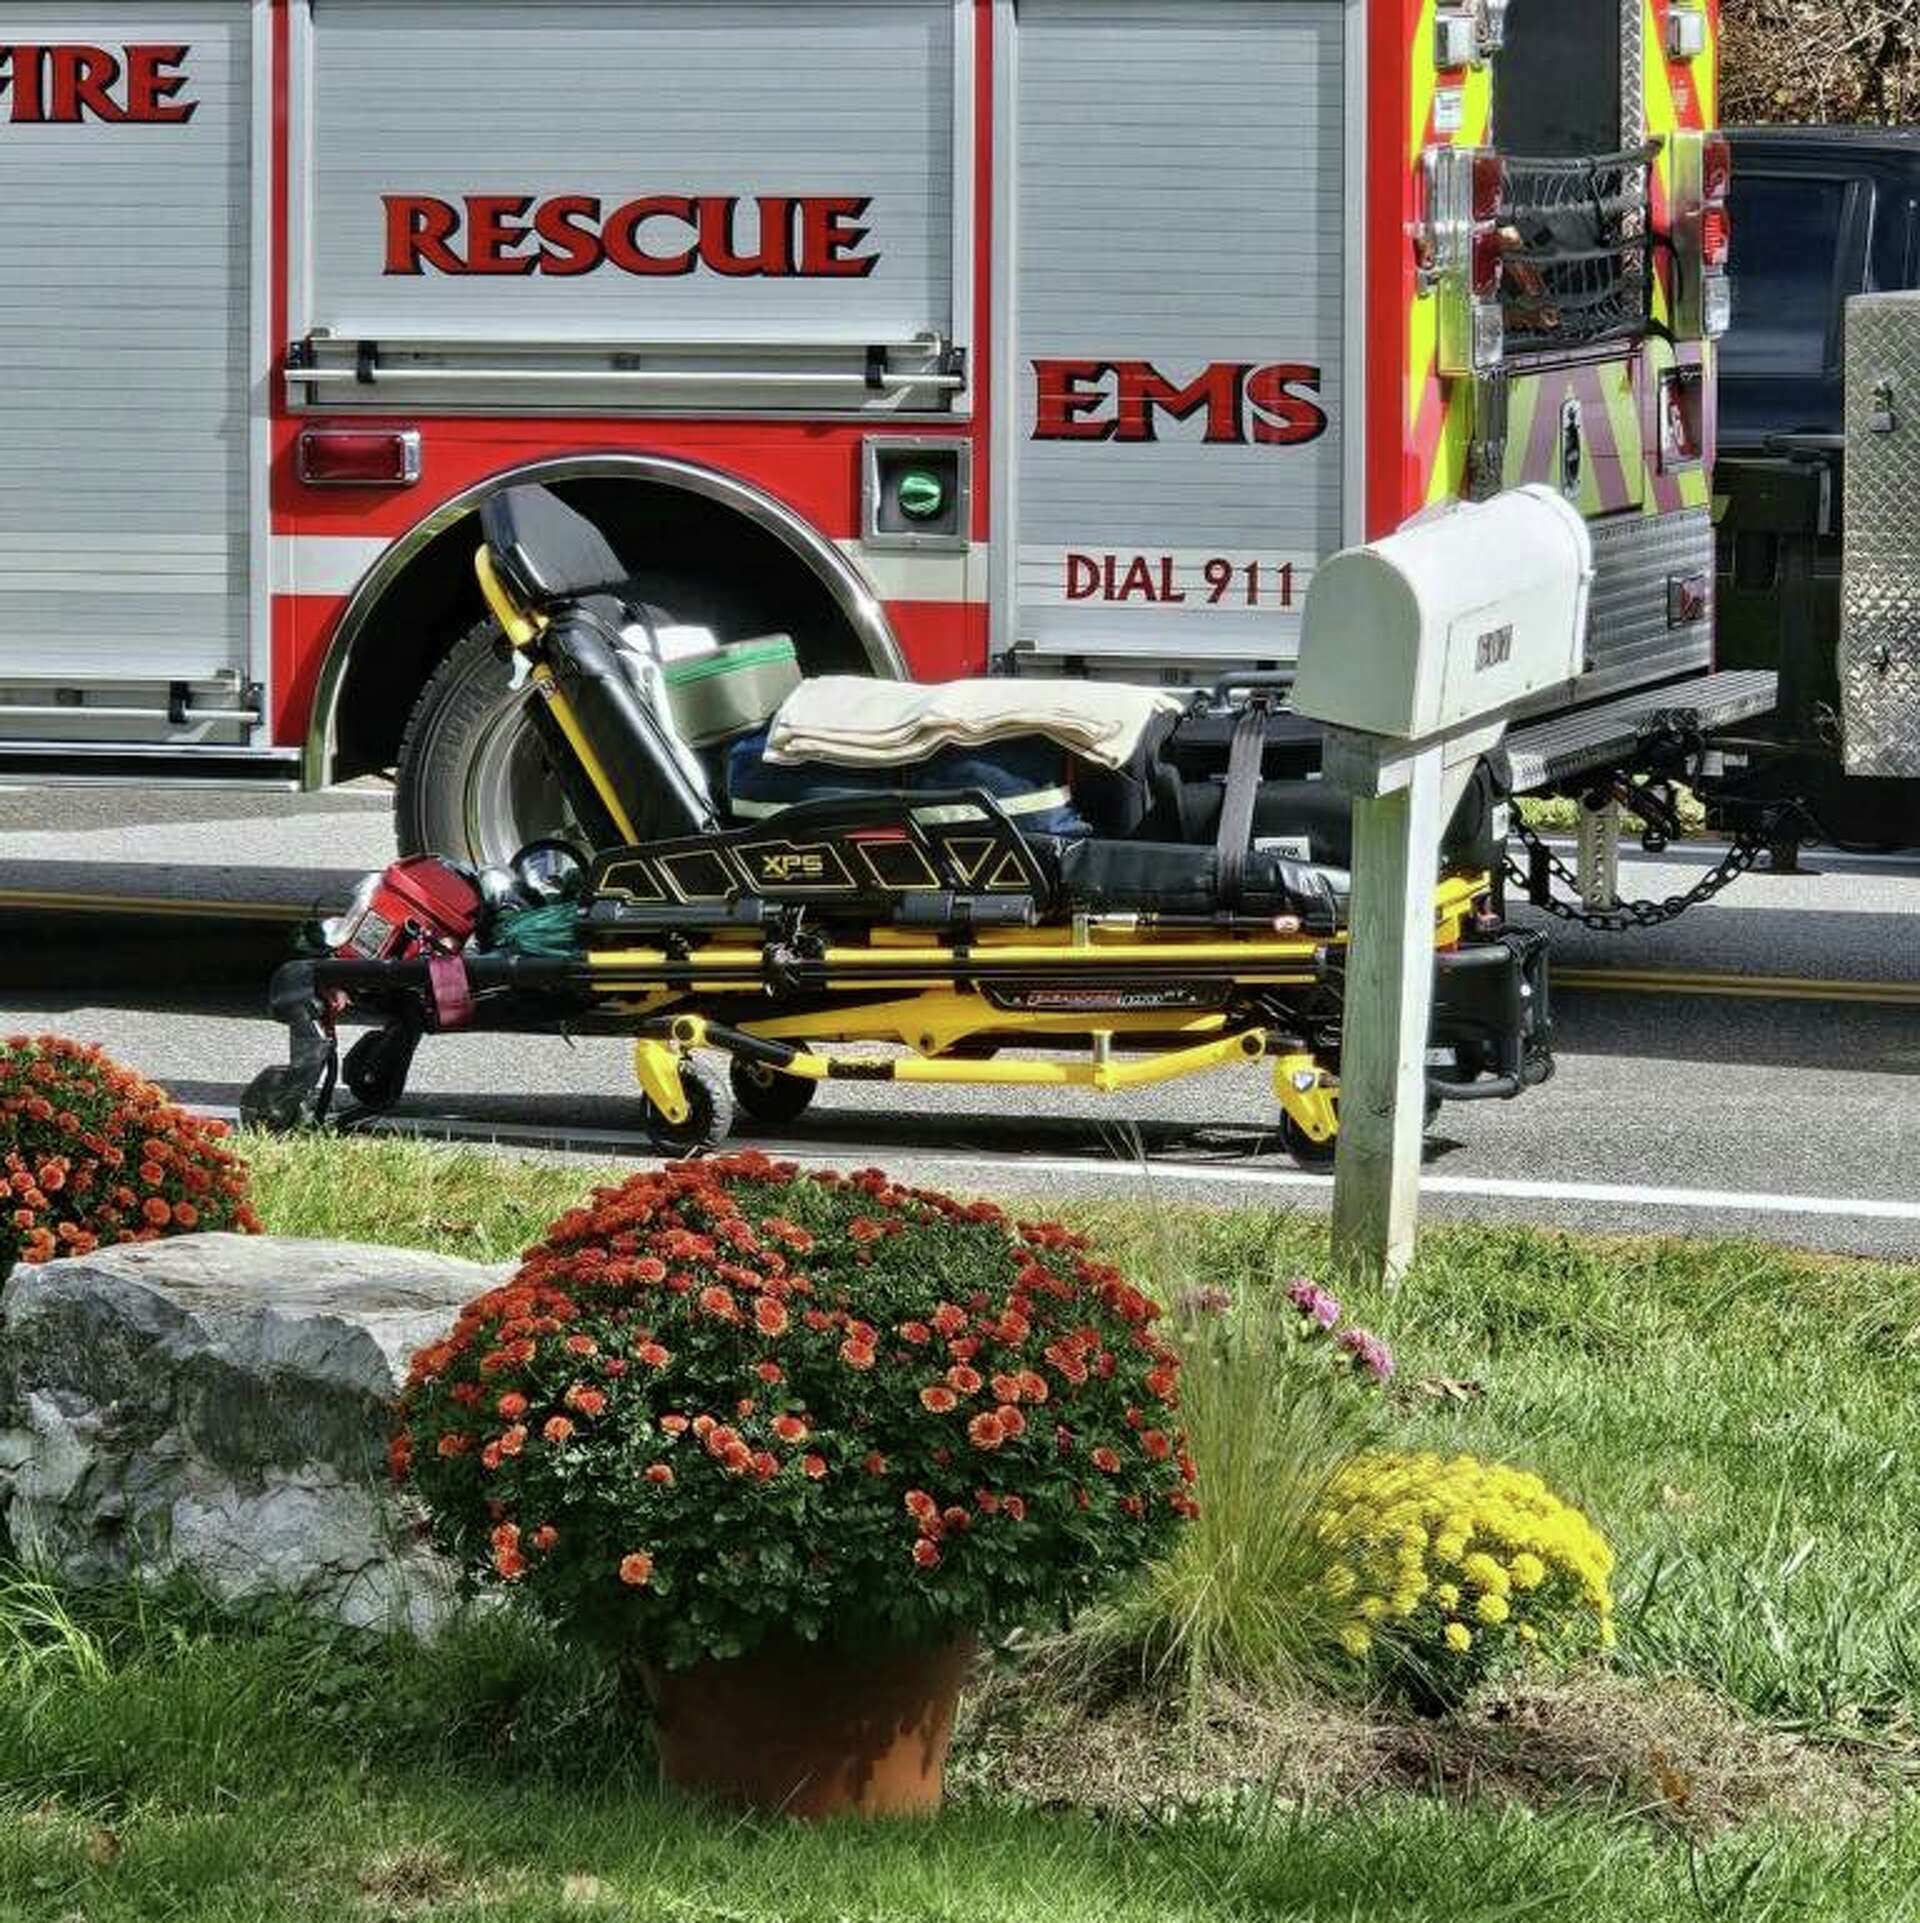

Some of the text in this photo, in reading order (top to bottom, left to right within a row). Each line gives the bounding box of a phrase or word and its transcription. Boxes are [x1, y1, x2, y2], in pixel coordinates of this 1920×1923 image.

[0, 45, 200, 123] IRE
[382, 195, 881, 278] RESCUE
[1030, 359, 1328, 446] EMS
[1066, 554, 1293, 606] DIAL 911
[761, 854, 823, 879] XPS
